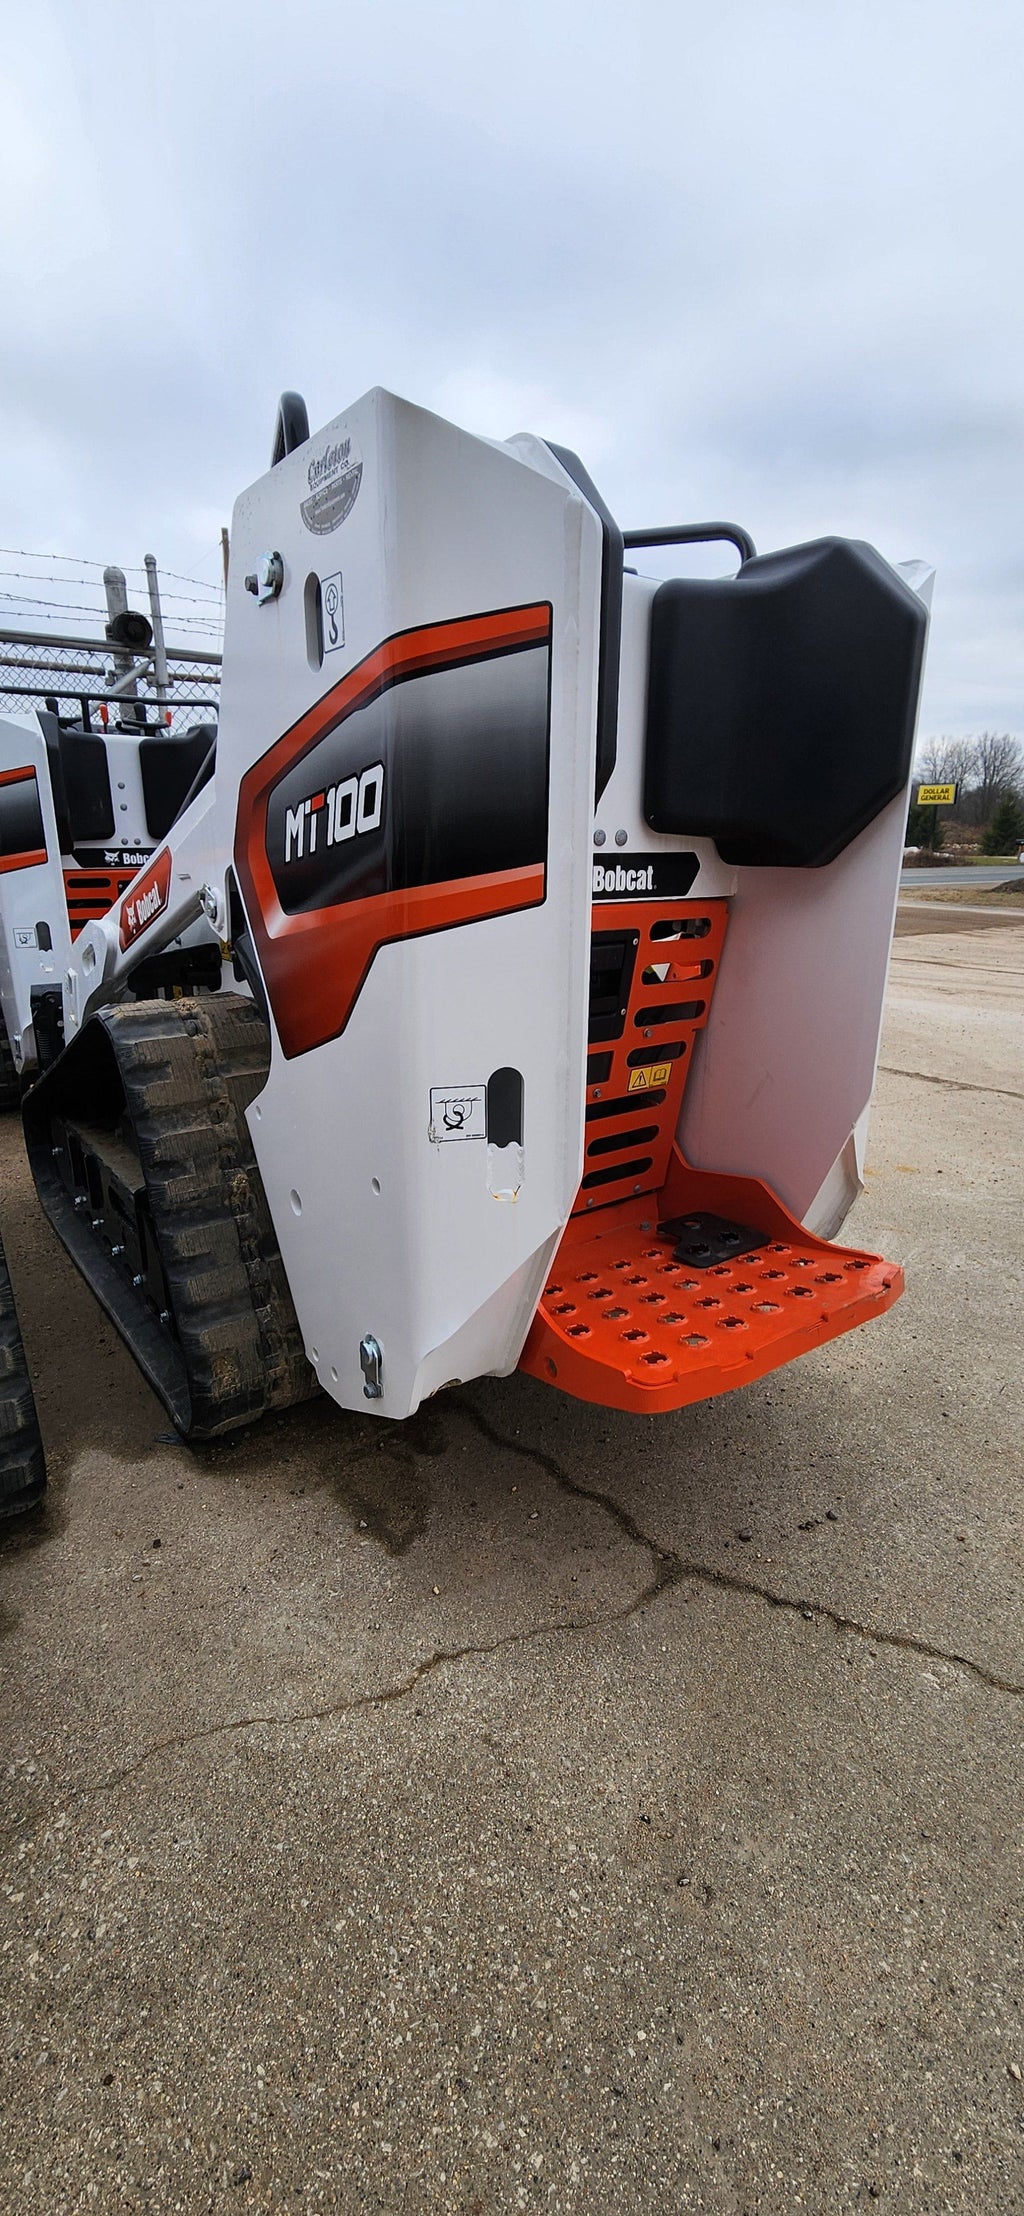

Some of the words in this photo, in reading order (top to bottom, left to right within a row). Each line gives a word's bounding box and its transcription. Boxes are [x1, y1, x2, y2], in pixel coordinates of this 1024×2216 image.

[285, 763, 384, 862] MT100
[592, 864, 654, 892] Bobcat
[136, 881, 162, 926] Bobcat
